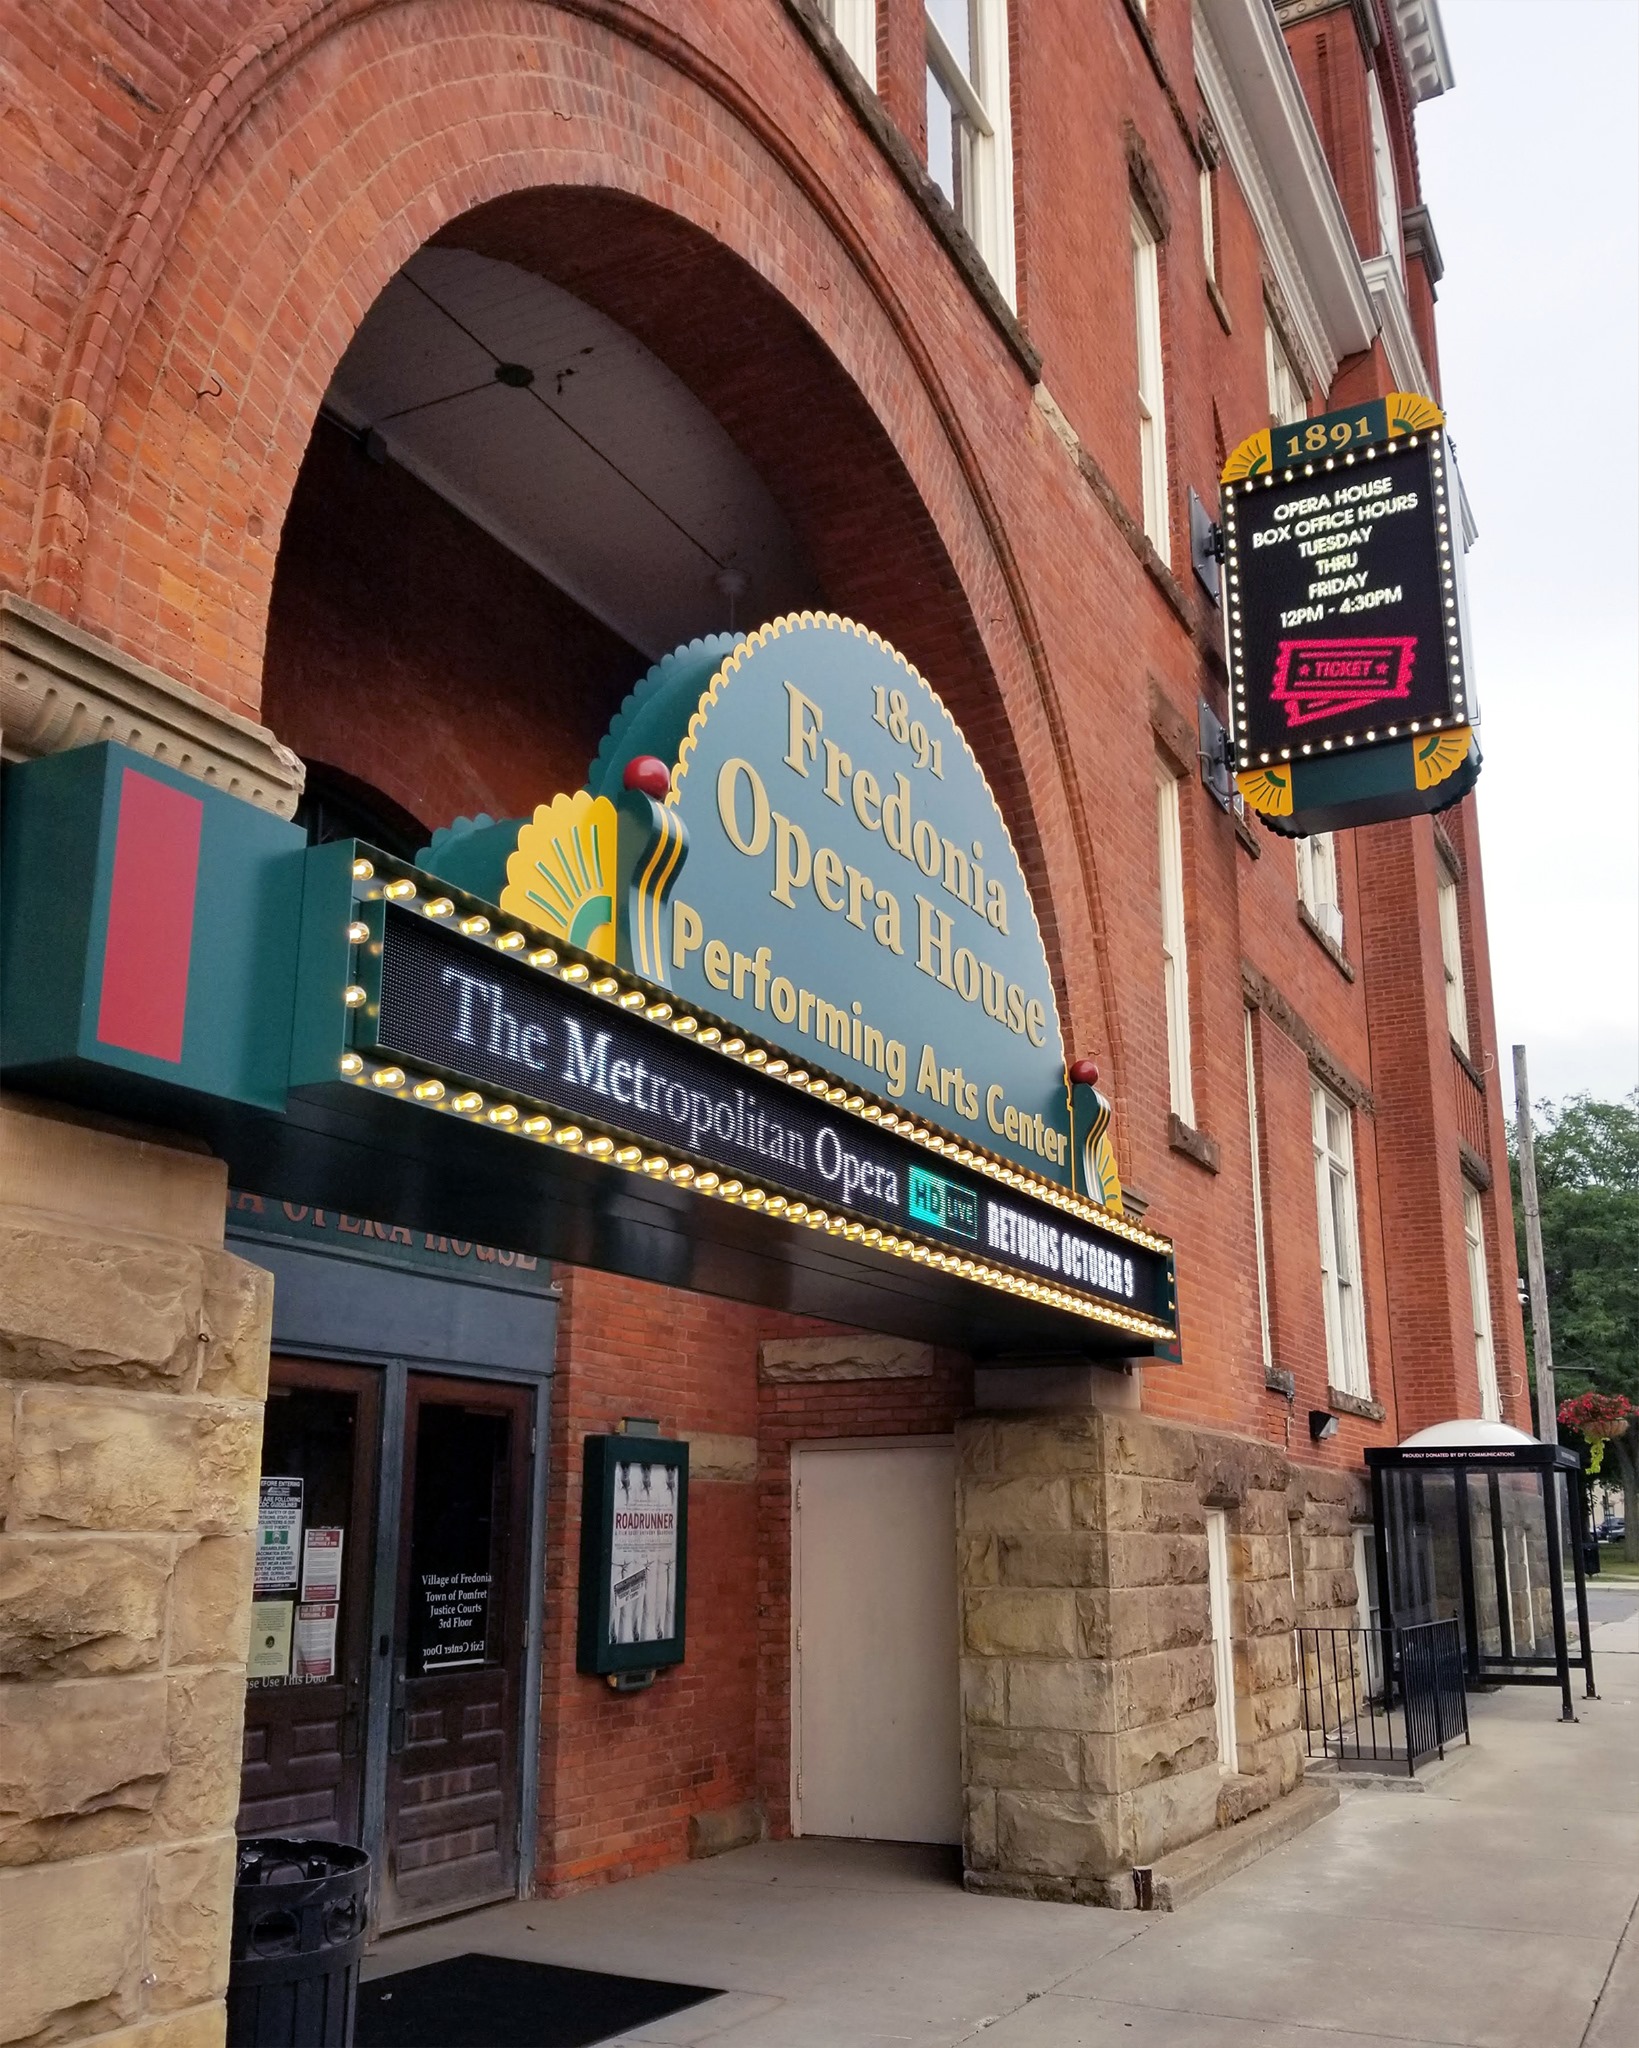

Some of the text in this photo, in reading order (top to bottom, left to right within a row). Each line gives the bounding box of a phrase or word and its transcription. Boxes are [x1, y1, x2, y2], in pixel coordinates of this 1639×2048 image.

[1286, 416, 1372, 458] 1891
[1274, 476, 1394, 522] OPERA HOUSE
[1253, 492, 1418, 550] BOX OFFICE HOURS
[1298, 525, 1373, 558] TUESDAY
[1315, 551, 1358, 576] THRU
[1308, 570, 1368, 599] FRIDAY
[1280, 603, 1324, 629] 12PM
[1339, 585, 1403, 616] 4:30PM
[1313, 660, 1373, 679] TICKET
[873, 684, 944, 780] 1891
[784, 680, 1010, 936] Fredonia
[717, 758, 1047, 1048] Opera House
[671, 899, 1069, 1167] Performing Arts Center
[442, 965, 548, 1070] The
[561, 1016, 806, 1170] Metropolitan
[814, 1126, 899, 1205] Opera
[987, 1200, 1060, 1271] RETURNS
[1061, 1232, 1123, 1294] OCTOBER
[1124, 1258, 1134, 1298] 9
[615, 1512, 674, 1529] ROADRUNNER
[421, 1572, 492, 1588] Village of Fredonia
[425, 1588, 488, 1602] Town of Pomfret
[430, 1603, 482, 1618] Justice Courts
[438, 1617, 473, 1629] 3rd Floor
[262, 1675, 280, 1688] Use
[282, 1674, 302, 1687] This
[305, 1673, 328, 1685] Door
